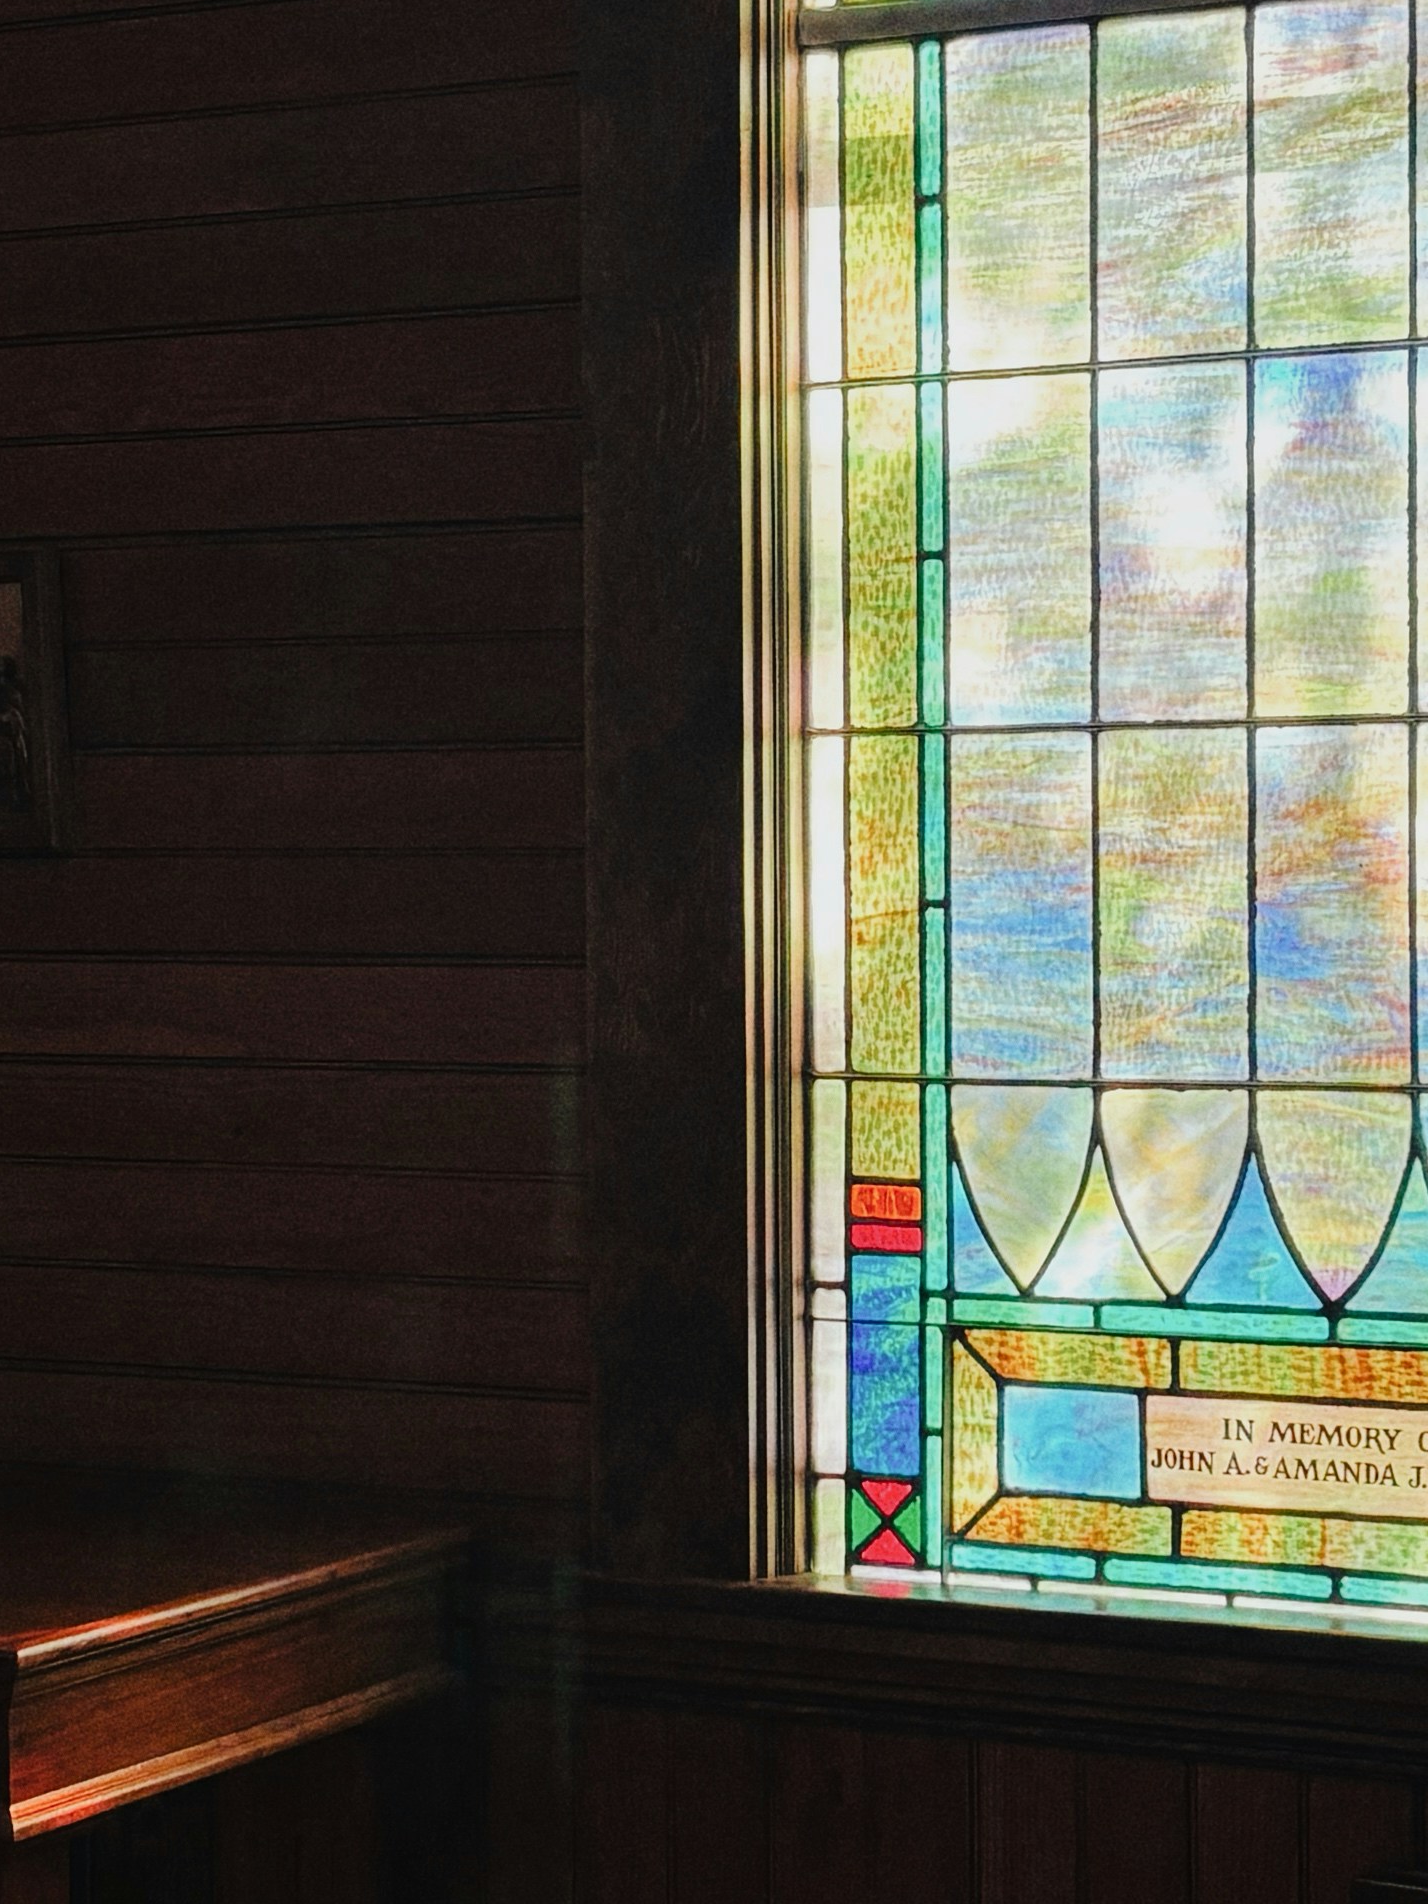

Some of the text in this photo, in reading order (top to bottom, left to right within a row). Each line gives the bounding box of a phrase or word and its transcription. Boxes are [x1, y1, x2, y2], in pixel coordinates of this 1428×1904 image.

[1222, 1417, 1254, 1443] IN
[1268, 1421, 1402, 1454] MEMORY
[1151, 1447, 1214, 1475] JOHN
[1223, 1452, 1250, 1476] A.
[1255, 1456, 1269, 1476] &
[1273, 1457, 1400, 1487] AMANDA
[1409, 1465, 1428, 1490] J.
